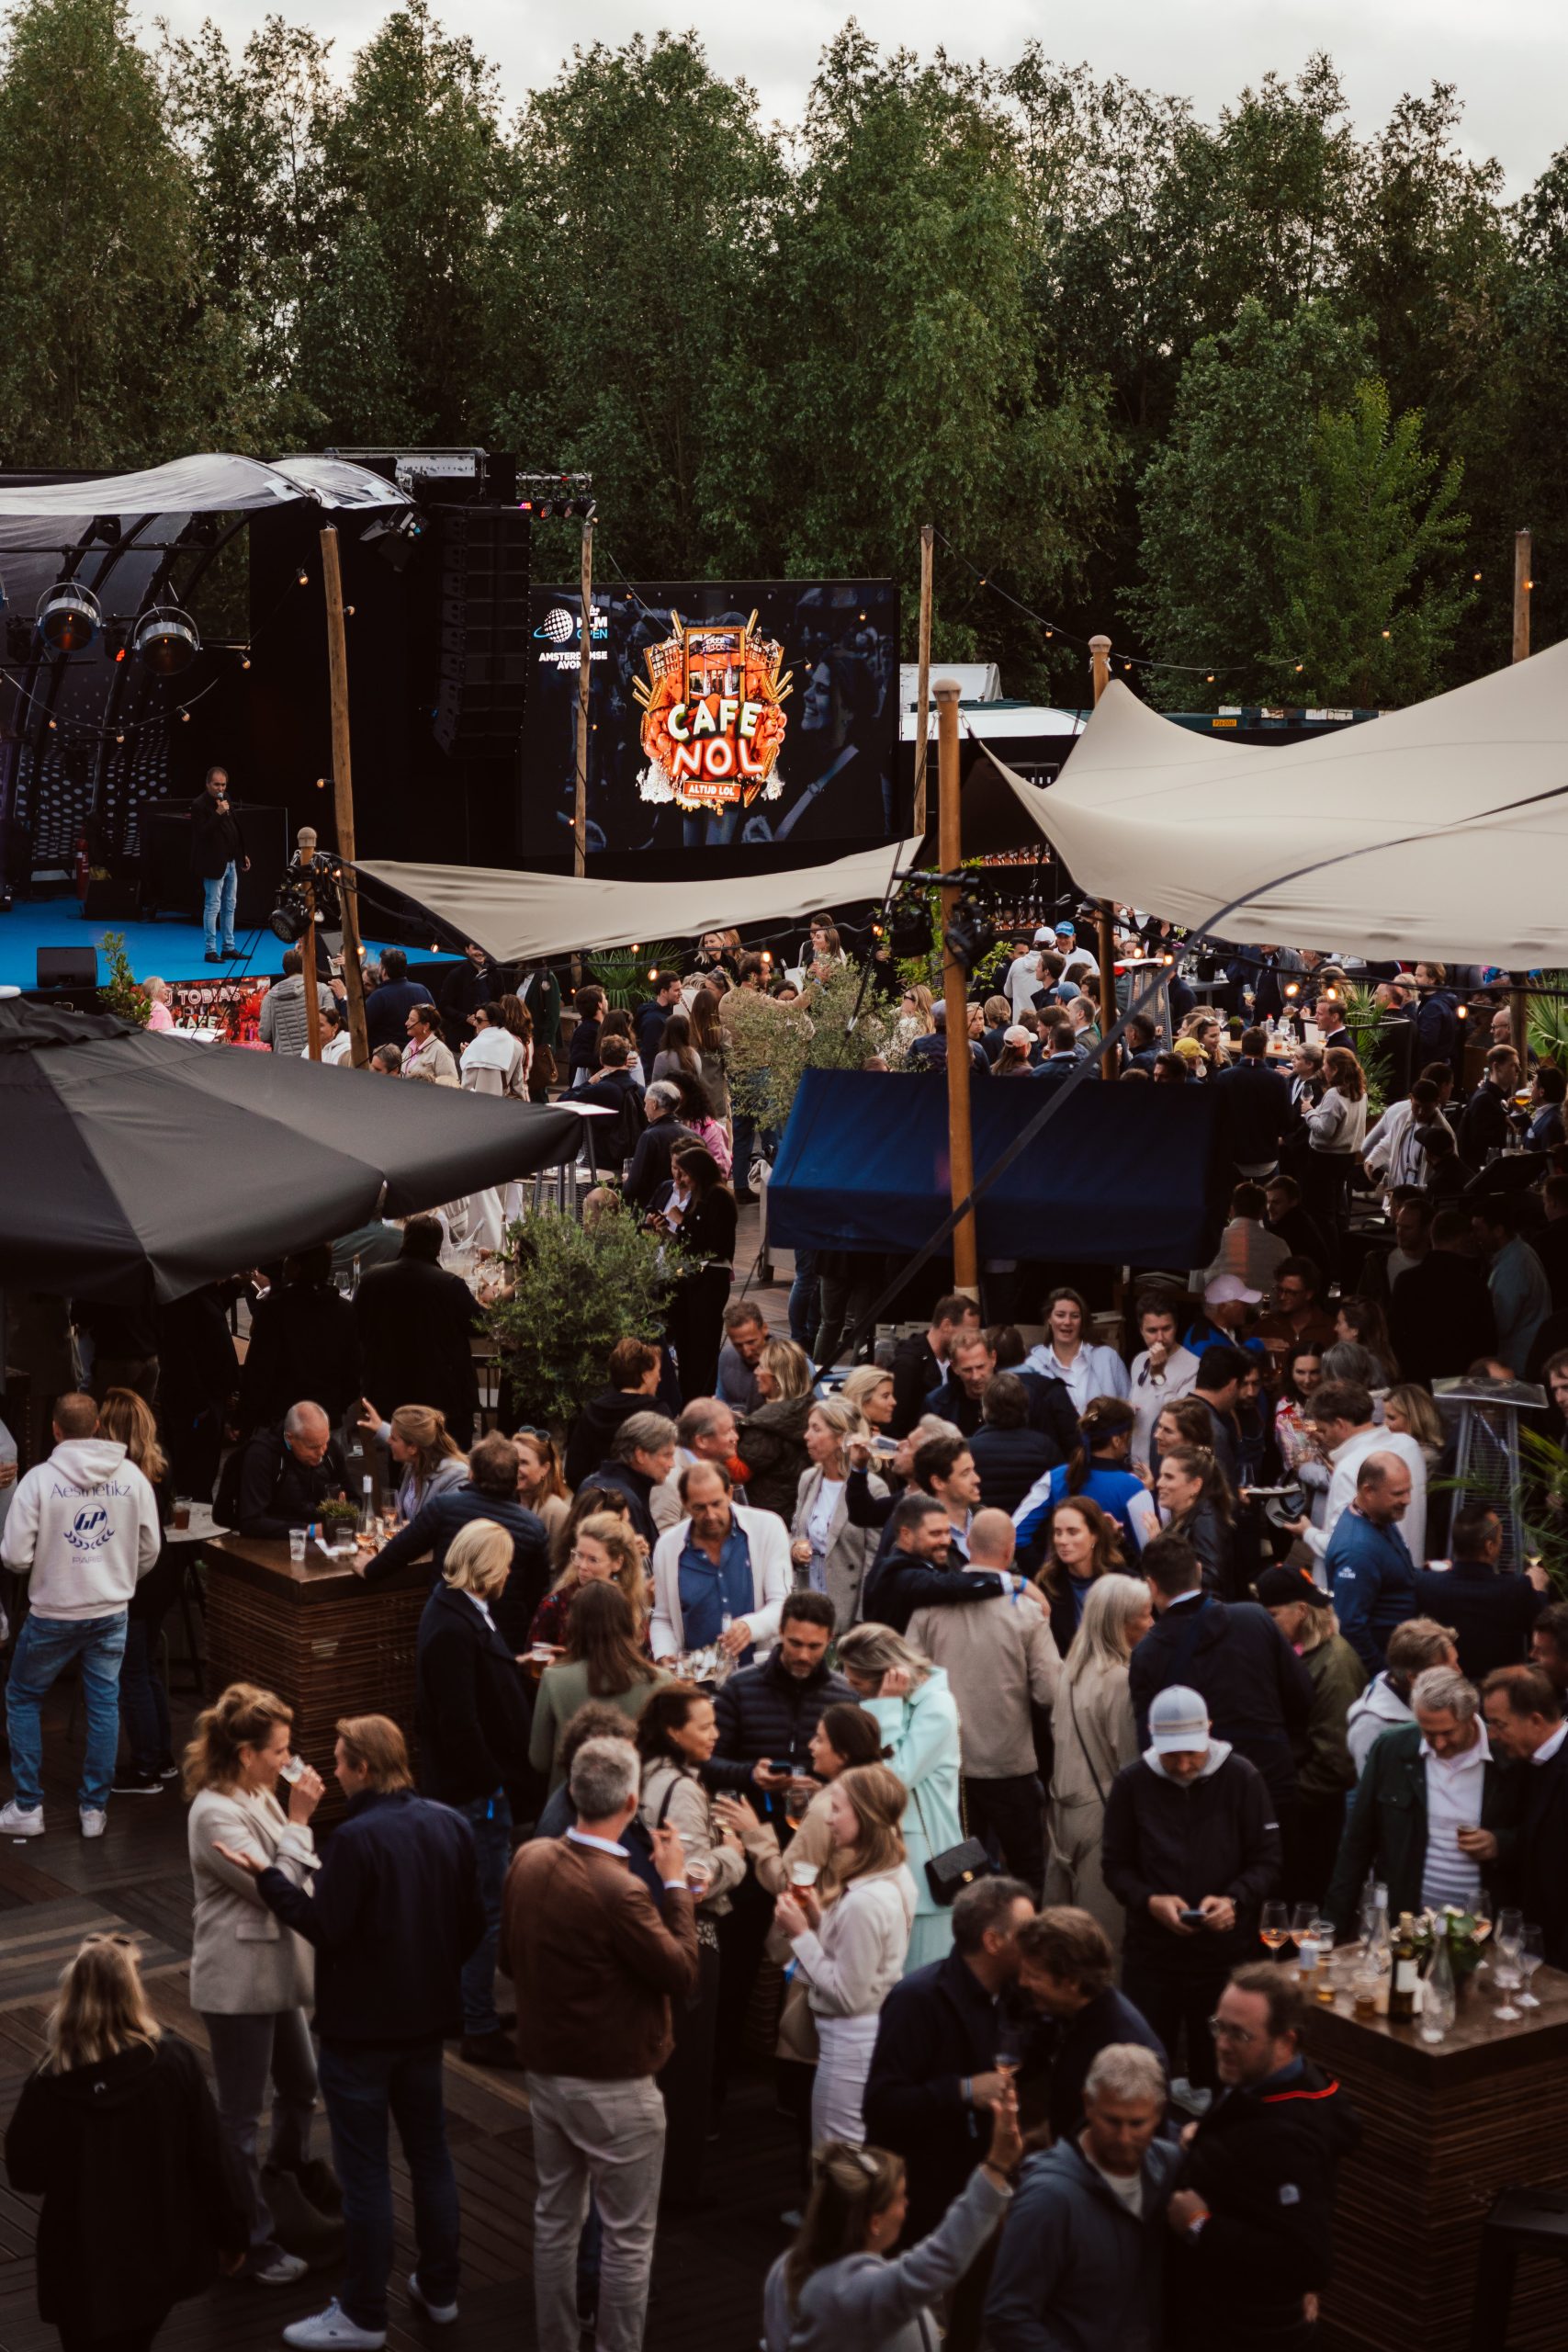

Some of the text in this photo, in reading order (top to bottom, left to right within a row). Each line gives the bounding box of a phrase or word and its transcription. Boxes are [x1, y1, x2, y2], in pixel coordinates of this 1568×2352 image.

[538, 650, 608, 662] AMSTERDMSE
[668, 699, 762, 741] CAFE
[671, 738, 765, 775] NOL
[688, 784, 735, 797] ALTIJD LOL
